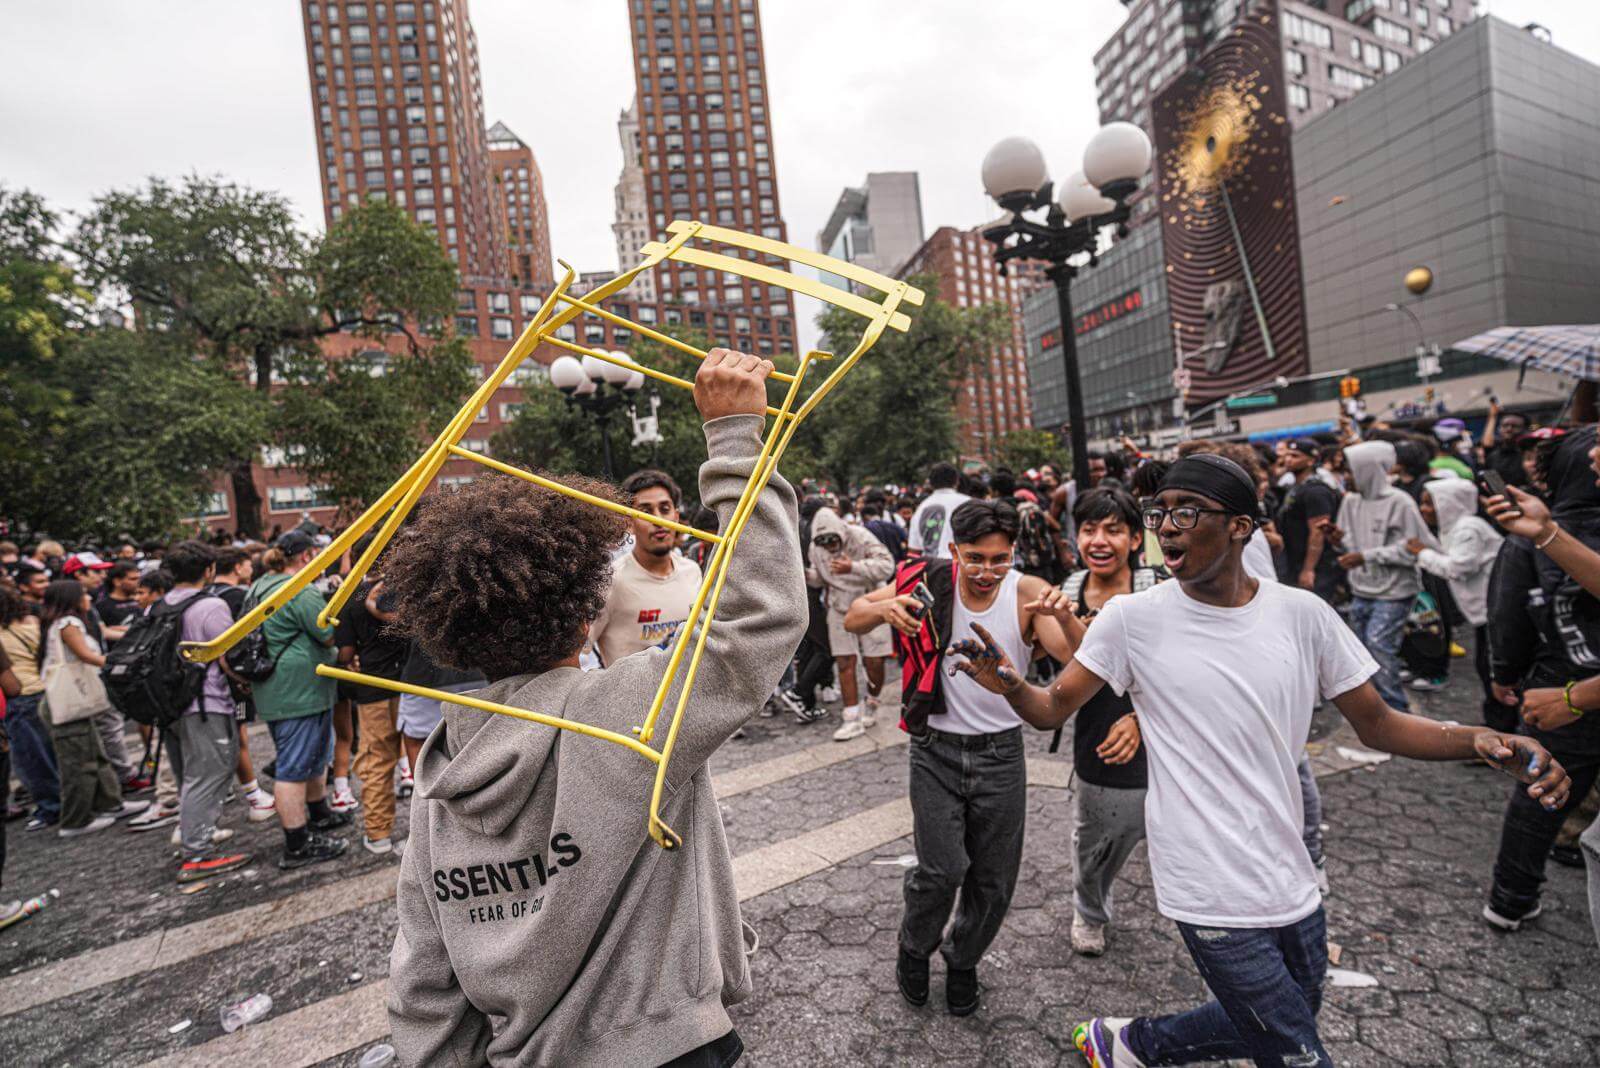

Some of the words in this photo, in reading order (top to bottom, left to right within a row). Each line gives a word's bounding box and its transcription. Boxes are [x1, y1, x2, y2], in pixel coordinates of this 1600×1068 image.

[433, 832, 582, 902] SSENTIS
[469, 904, 505, 924] FEAR
[511, 900, 527, 918] OF
